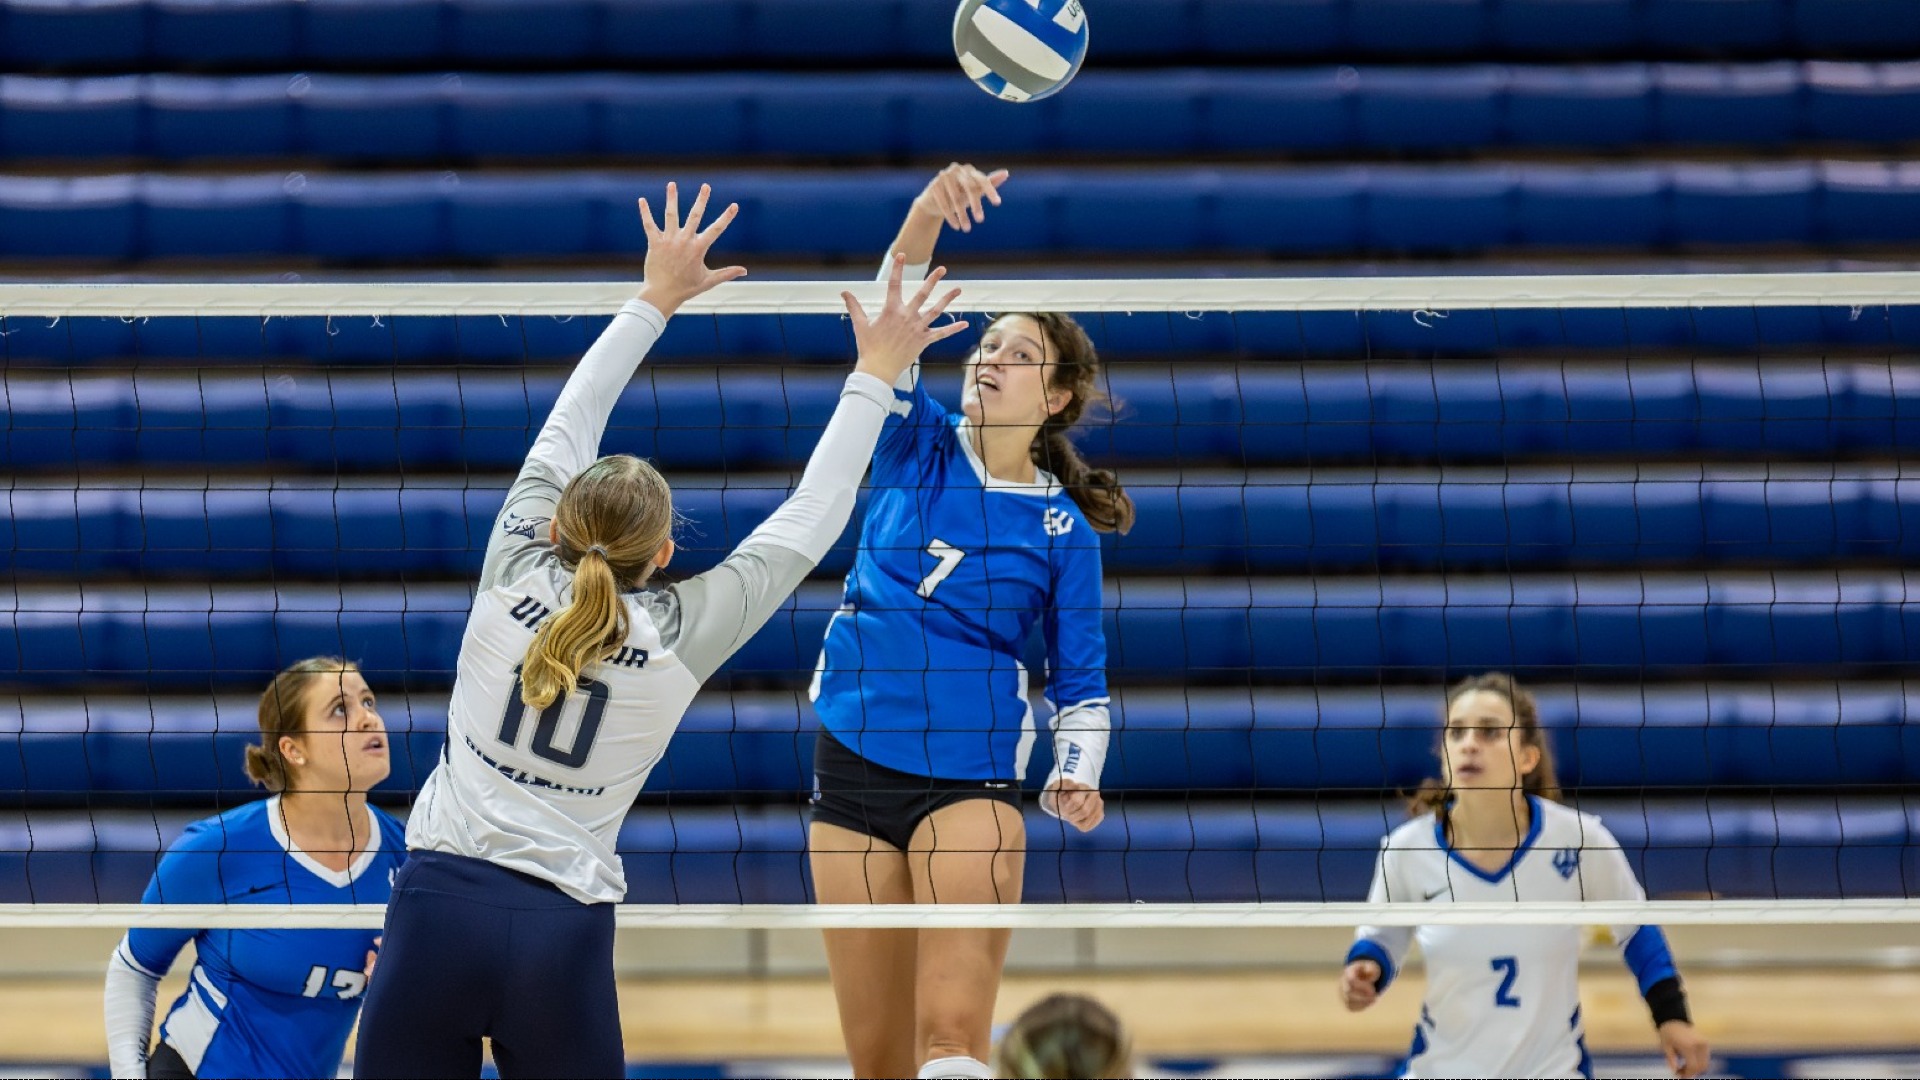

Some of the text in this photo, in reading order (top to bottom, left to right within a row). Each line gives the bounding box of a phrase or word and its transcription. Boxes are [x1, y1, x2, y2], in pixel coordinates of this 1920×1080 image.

[915, 537, 966, 599] 7
[495, 661, 612, 770] 10
[1490, 956, 1521, 1007] 2
